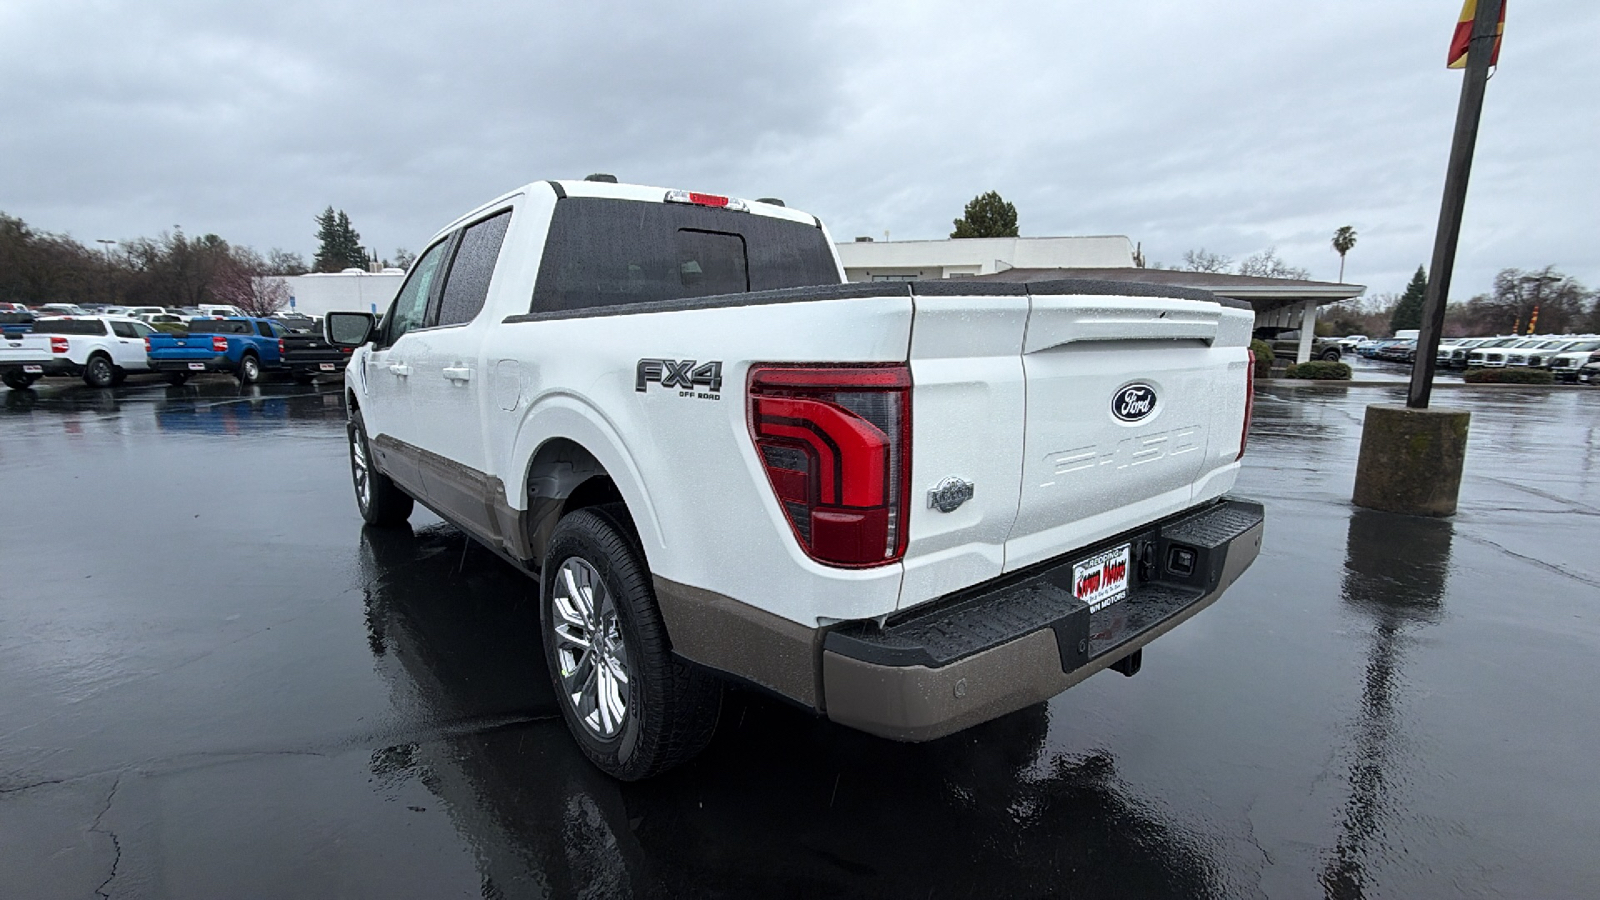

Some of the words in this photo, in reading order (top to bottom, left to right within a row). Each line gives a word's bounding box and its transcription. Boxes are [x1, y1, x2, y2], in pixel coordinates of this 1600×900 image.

[635, 358, 723, 393] FX4
[697, 392, 721, 401] ROAD
[1120, 388, 1152, 416] Ford
[1089, 549, 1120, 567] REDDING
[1101, 590, 1126, 609] MOTORS
